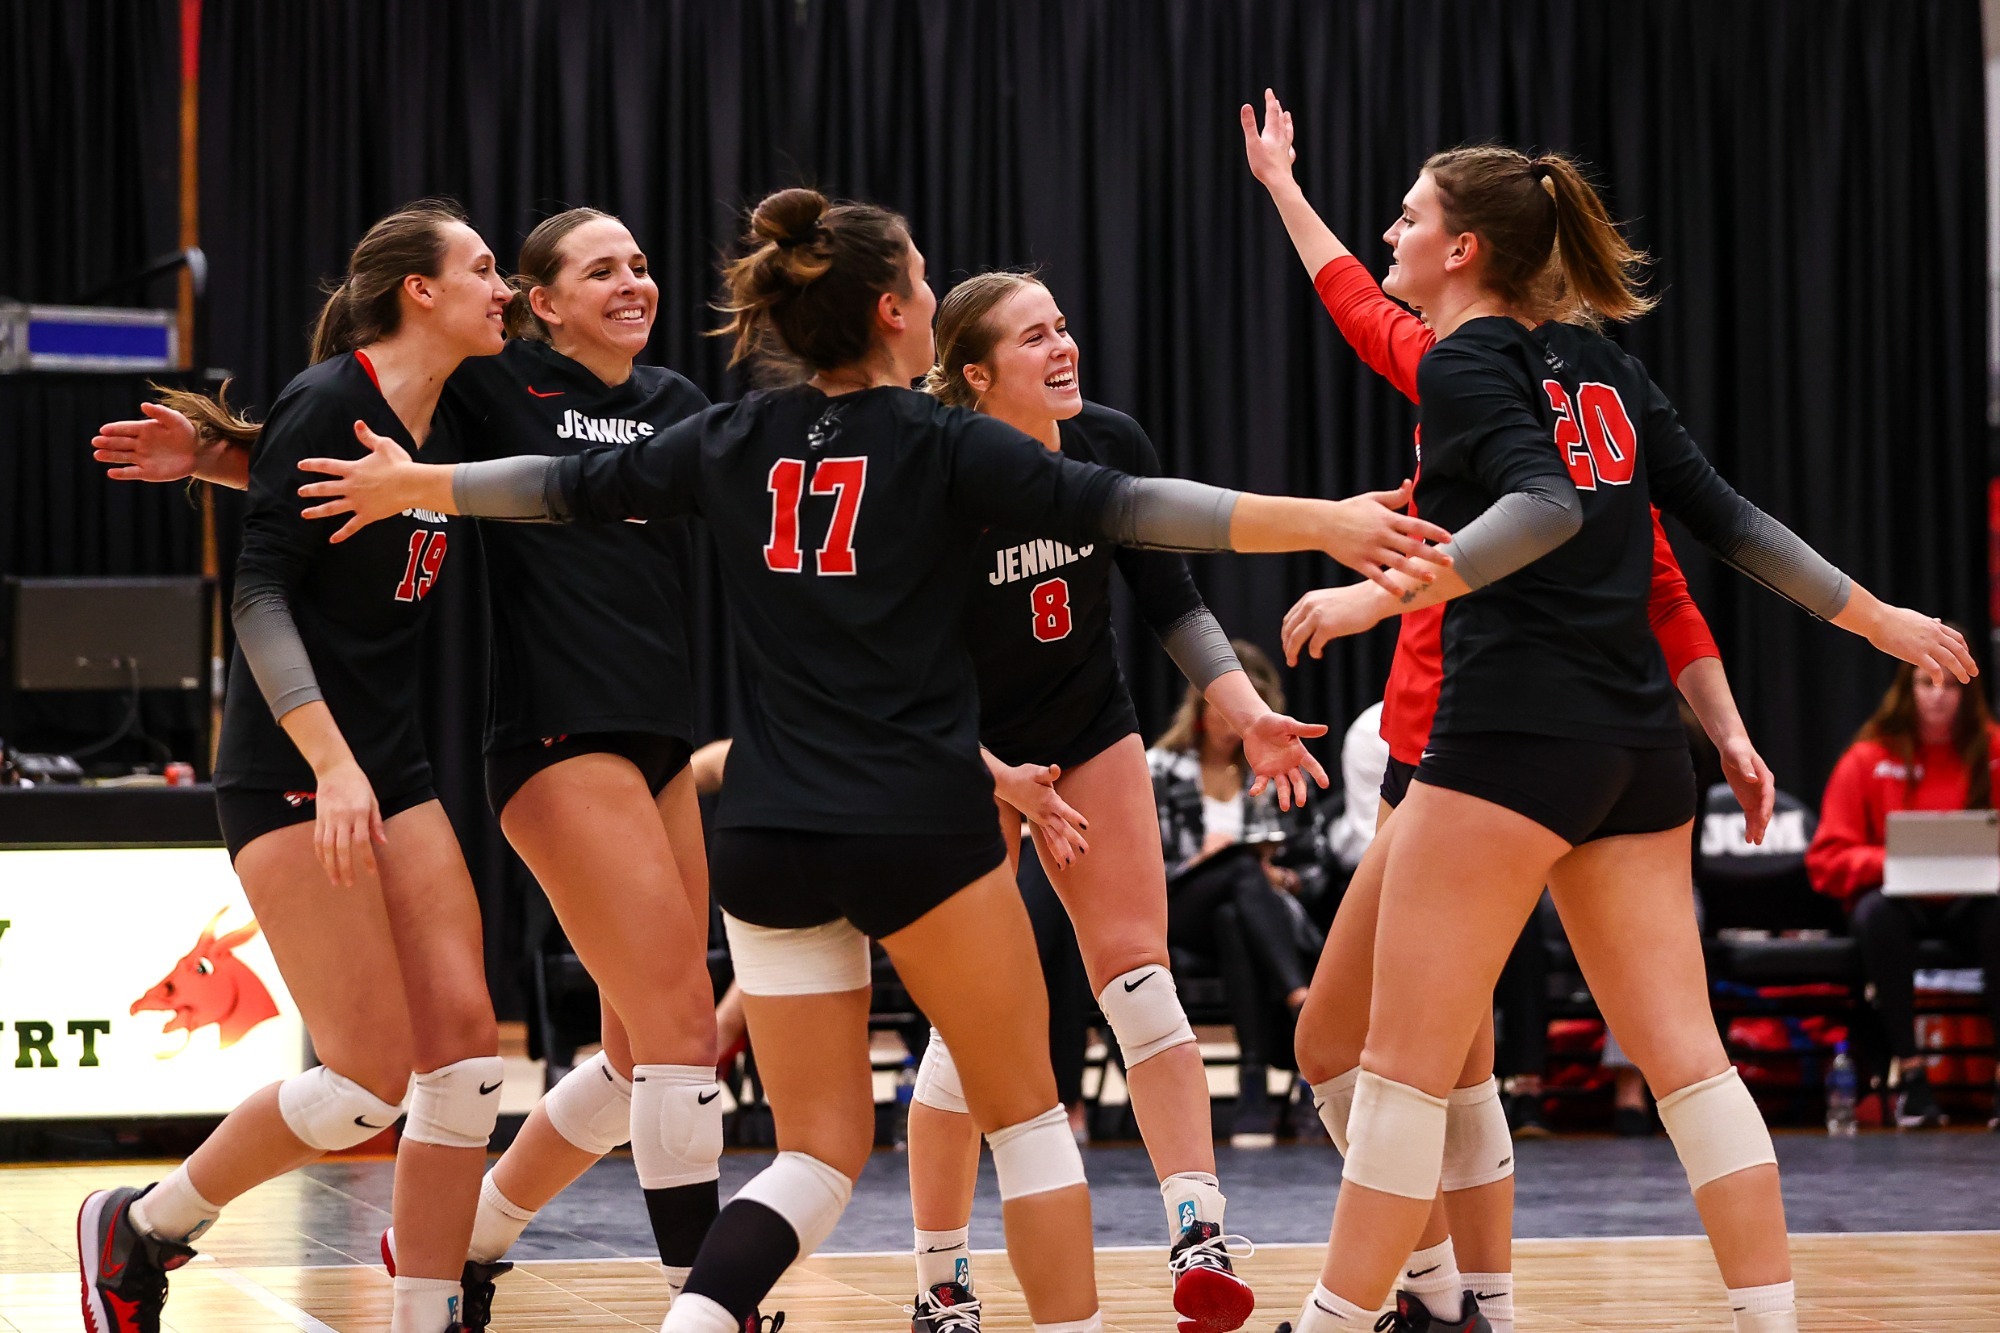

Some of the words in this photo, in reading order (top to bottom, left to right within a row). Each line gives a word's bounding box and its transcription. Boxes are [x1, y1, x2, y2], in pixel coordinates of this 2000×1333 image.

[1543, 379, 1637, 492] 20
[763, 456, 868, 576] 17
[394, 528, 448, 603] 19
[1030, 577, 1073, 643] 8
[0, 1020, 110, 1068] RT
